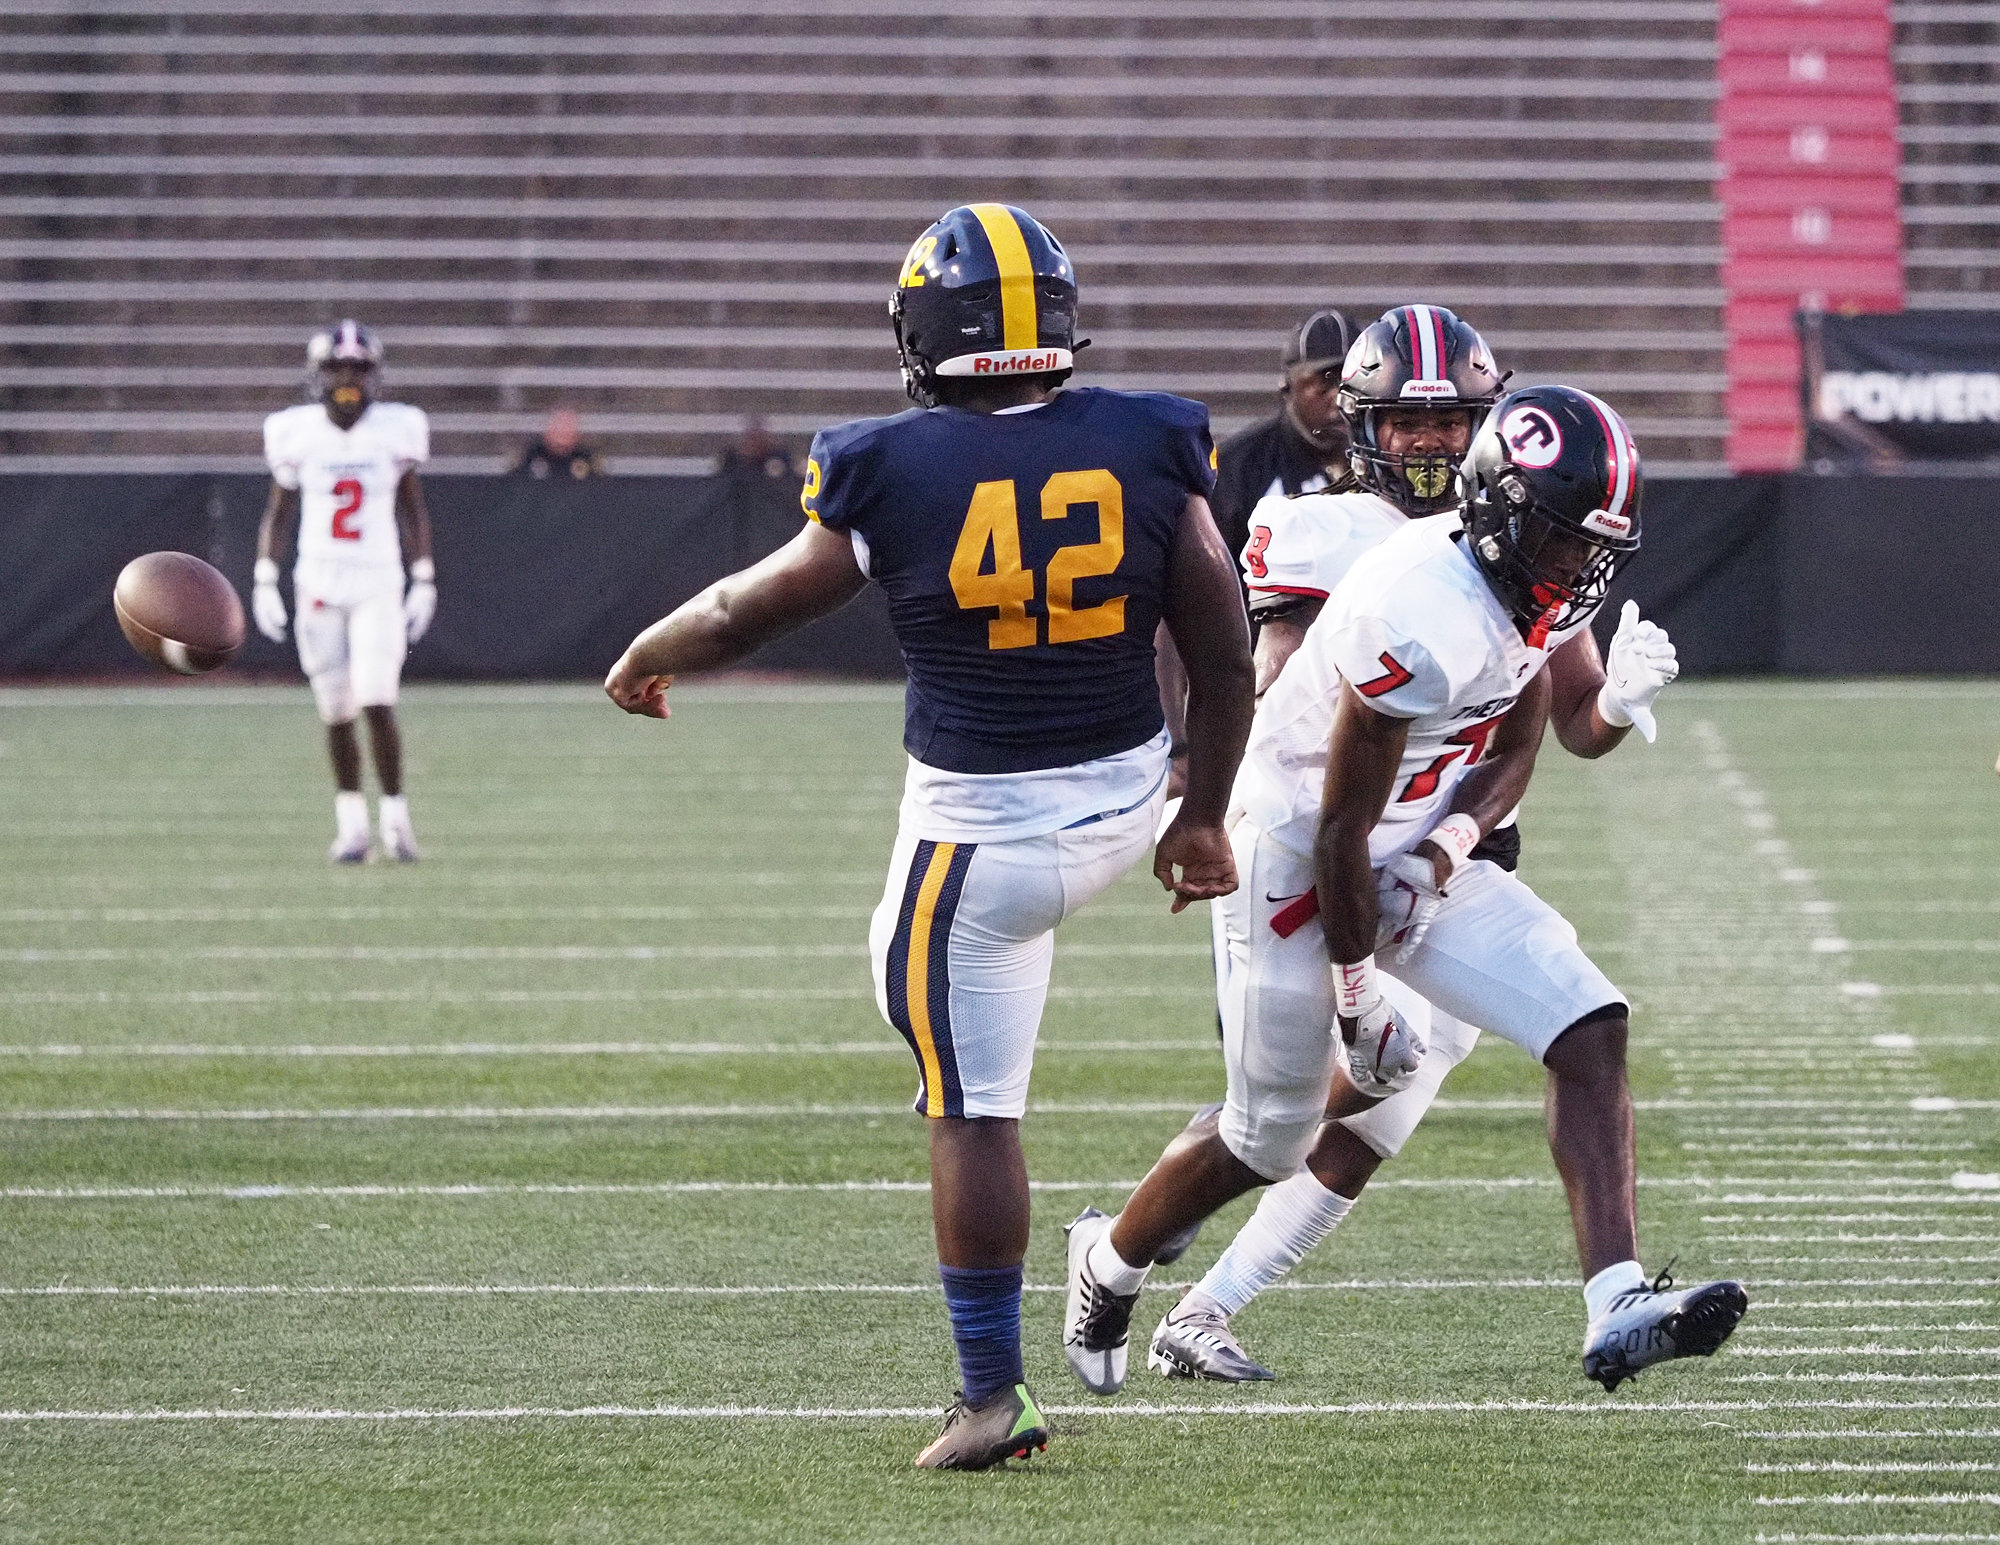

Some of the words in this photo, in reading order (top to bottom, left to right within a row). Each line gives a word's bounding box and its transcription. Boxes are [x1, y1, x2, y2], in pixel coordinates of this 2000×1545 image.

[974, 353, 1058, 373] Riddell
[1511, 411, 1555, 452] T
[332, 479, 363, 541] 2
[949, 469, 1128, 650] 42
[1246, 525, 1272, 578] 8
[1355, 651, 1414, 698] 7
